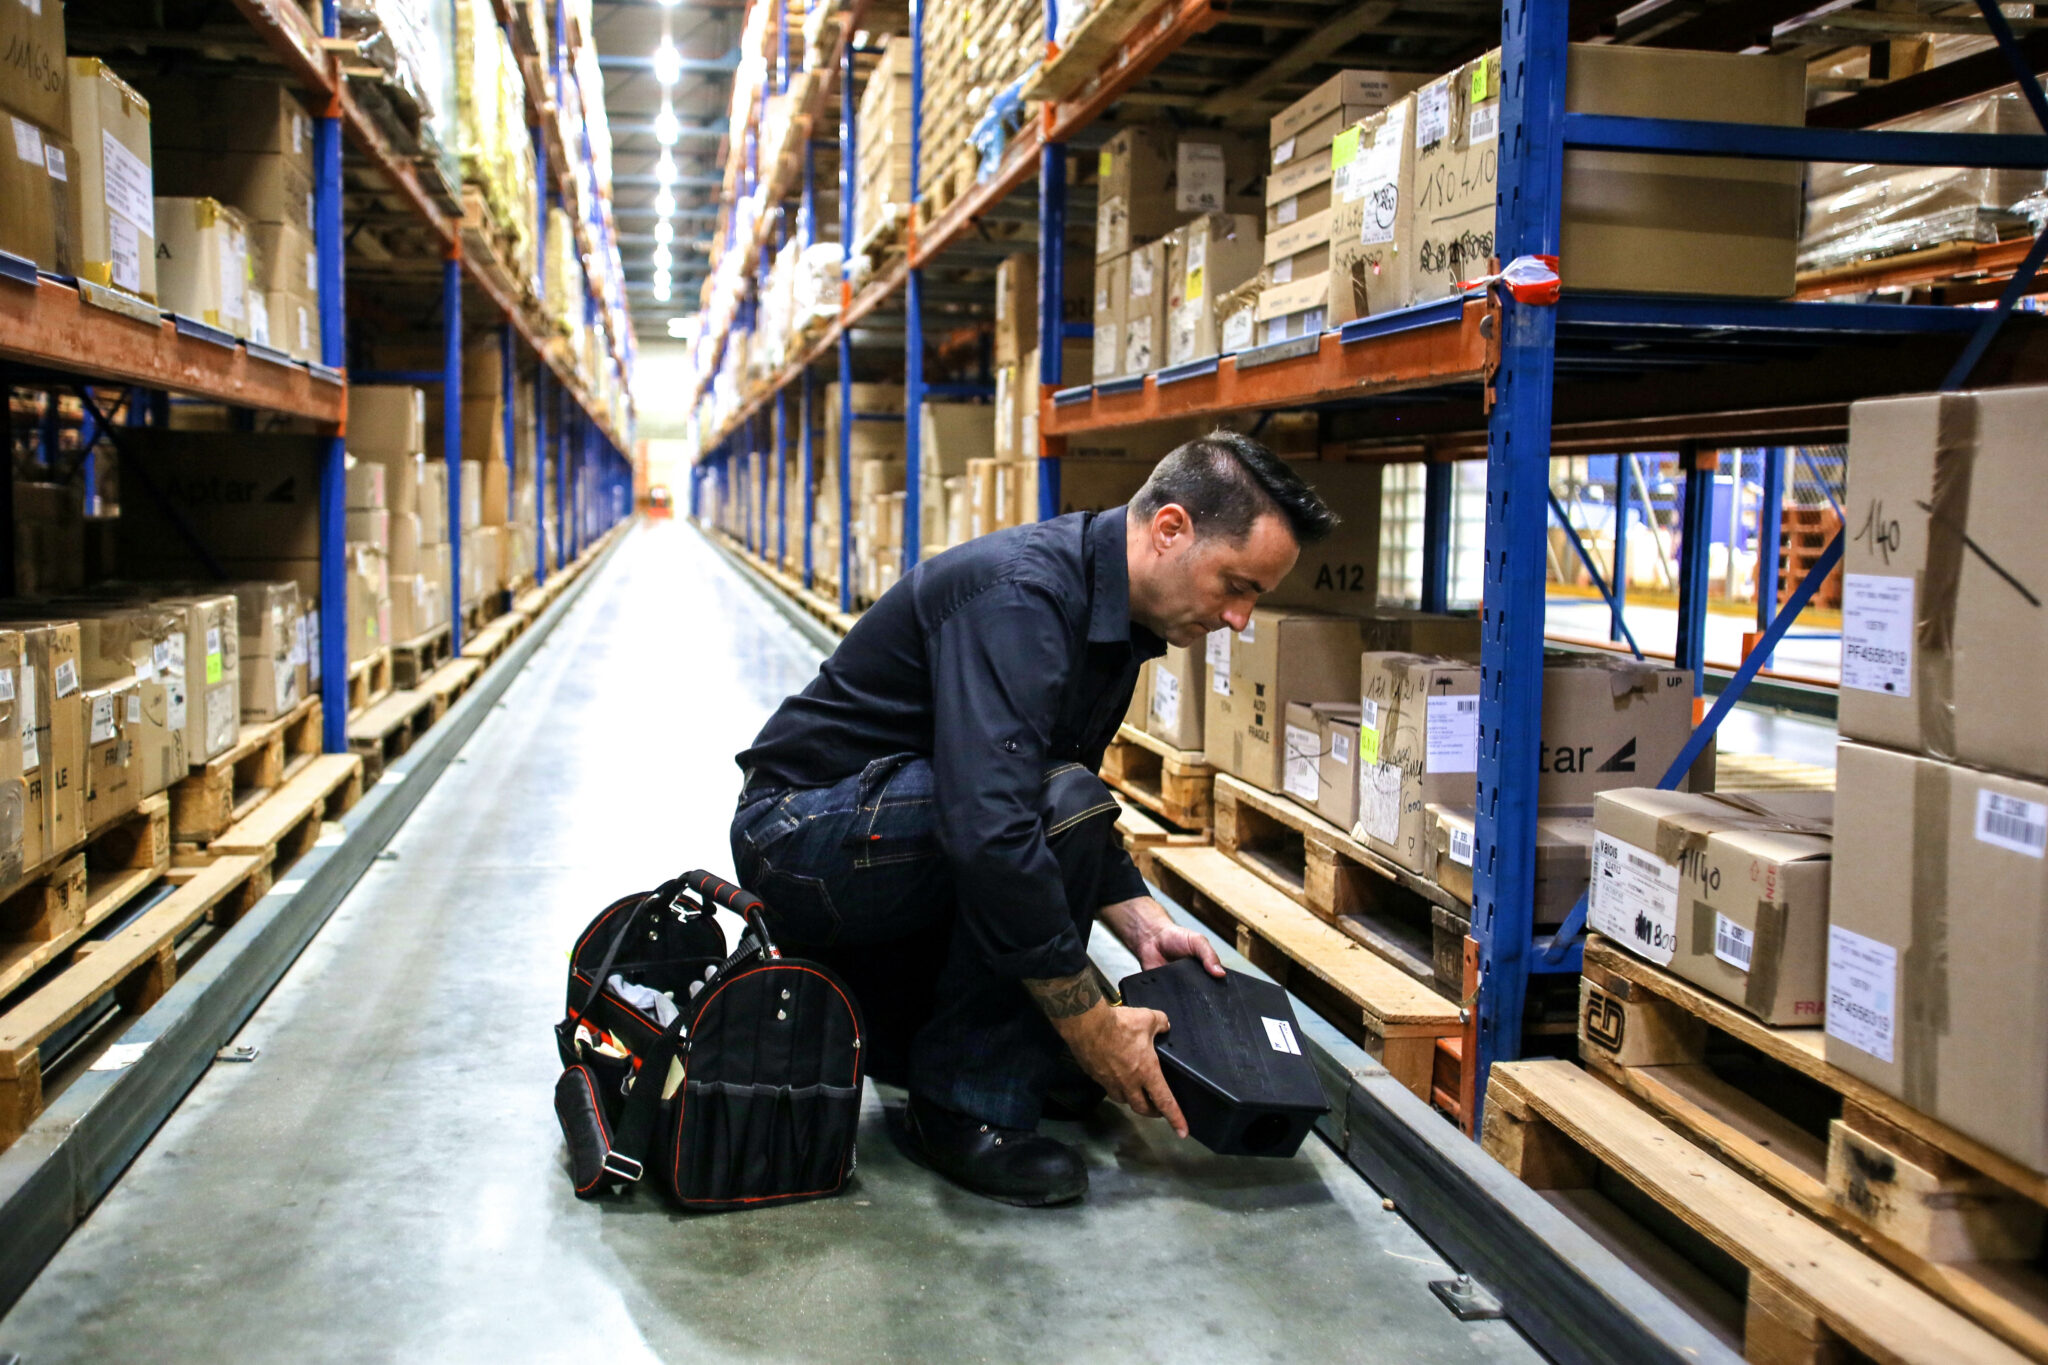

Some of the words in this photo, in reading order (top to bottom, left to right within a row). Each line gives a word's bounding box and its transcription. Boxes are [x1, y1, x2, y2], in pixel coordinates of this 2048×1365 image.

[156, 243, 172, 259] A
[1314, 563, 1364, 591] A12
[1667, 677, 1682, 687] UP
